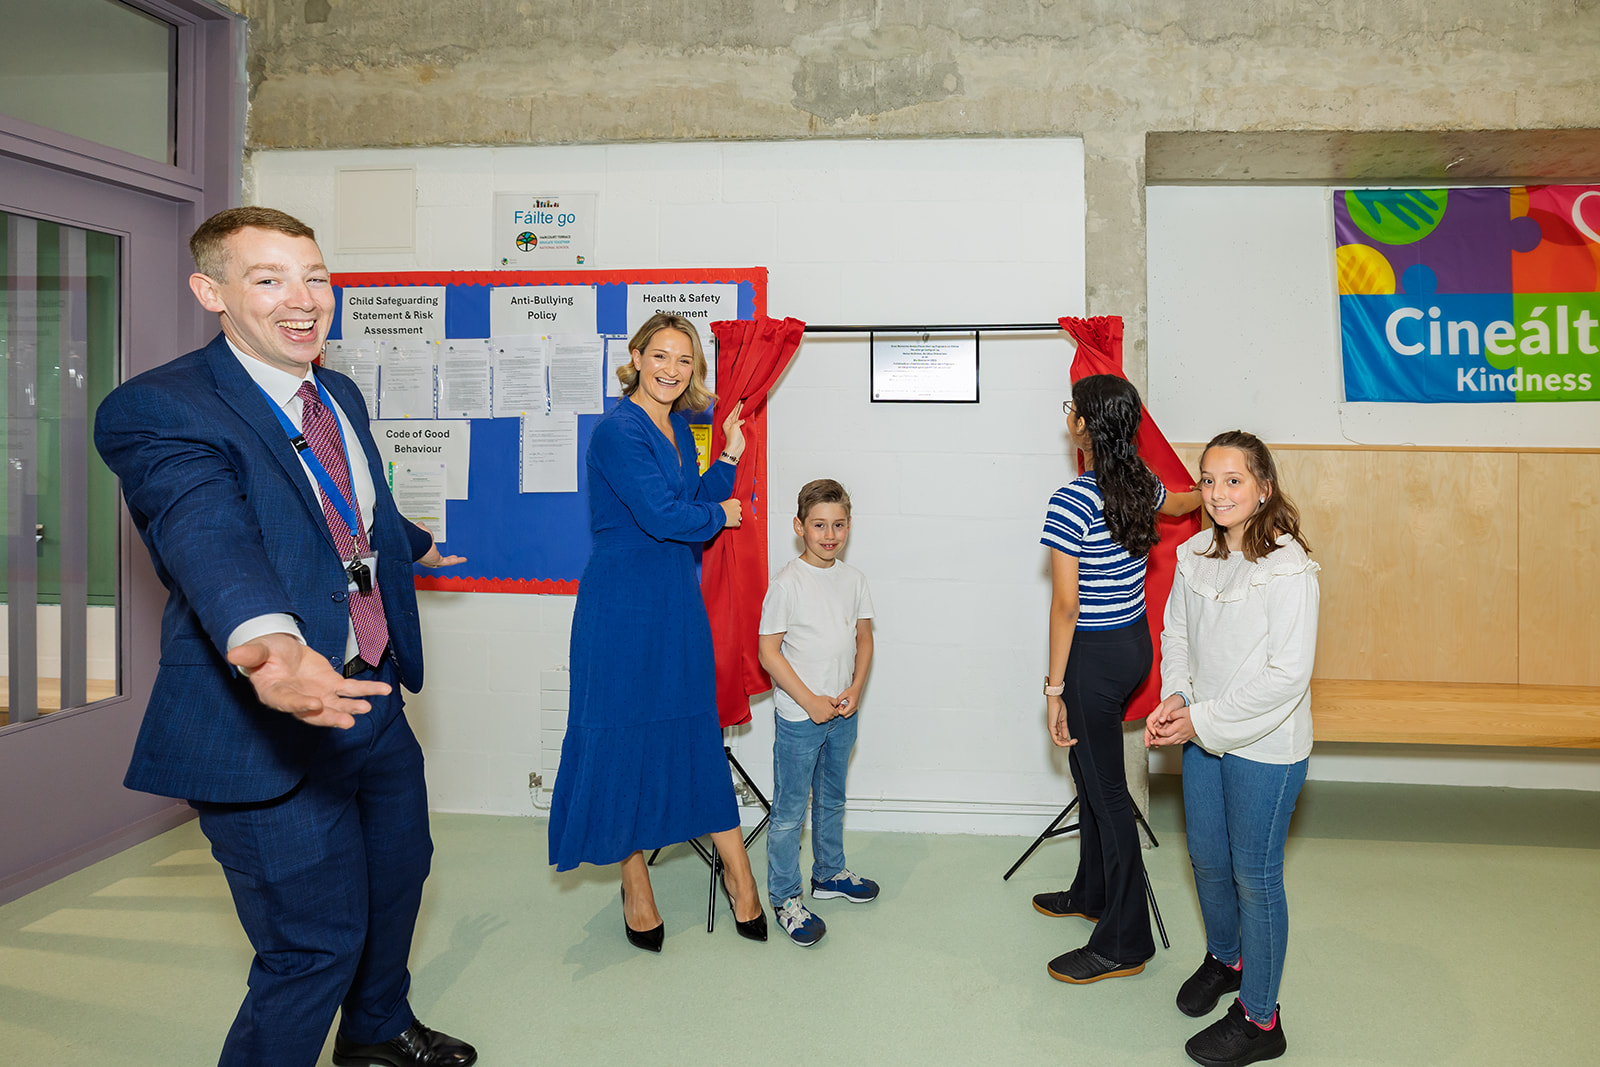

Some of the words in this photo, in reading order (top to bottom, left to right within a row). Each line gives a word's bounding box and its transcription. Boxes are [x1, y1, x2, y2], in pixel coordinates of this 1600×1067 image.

[514, 210, 553, 224] Fáilte
[558, 213, 576, 227] go
[349, 295, 374, 306] Child
[376, 295, 439, 308] Safeguarding
[510, 295, 574, 307] Anti-Bullying
[642, 293, 677, 303] Health
[679, 294, 687, 303] &
[689, 293, 721, 305] Safety
[352, 311, 403, 320] Statement
[405, 311, 412, 320] &
[414, 311, 434, 320] Risk
[527, 310, 557, 321] Policy
[363, 326, 424, 335] Assessment
[1457, 367, 1592, 392] Kindness
[386, 429, 410, 439] Code
[411, 429, 422, 439] of
[424, 429, 450, 439] Good
[394, 444, 442, 454] Behaviour
